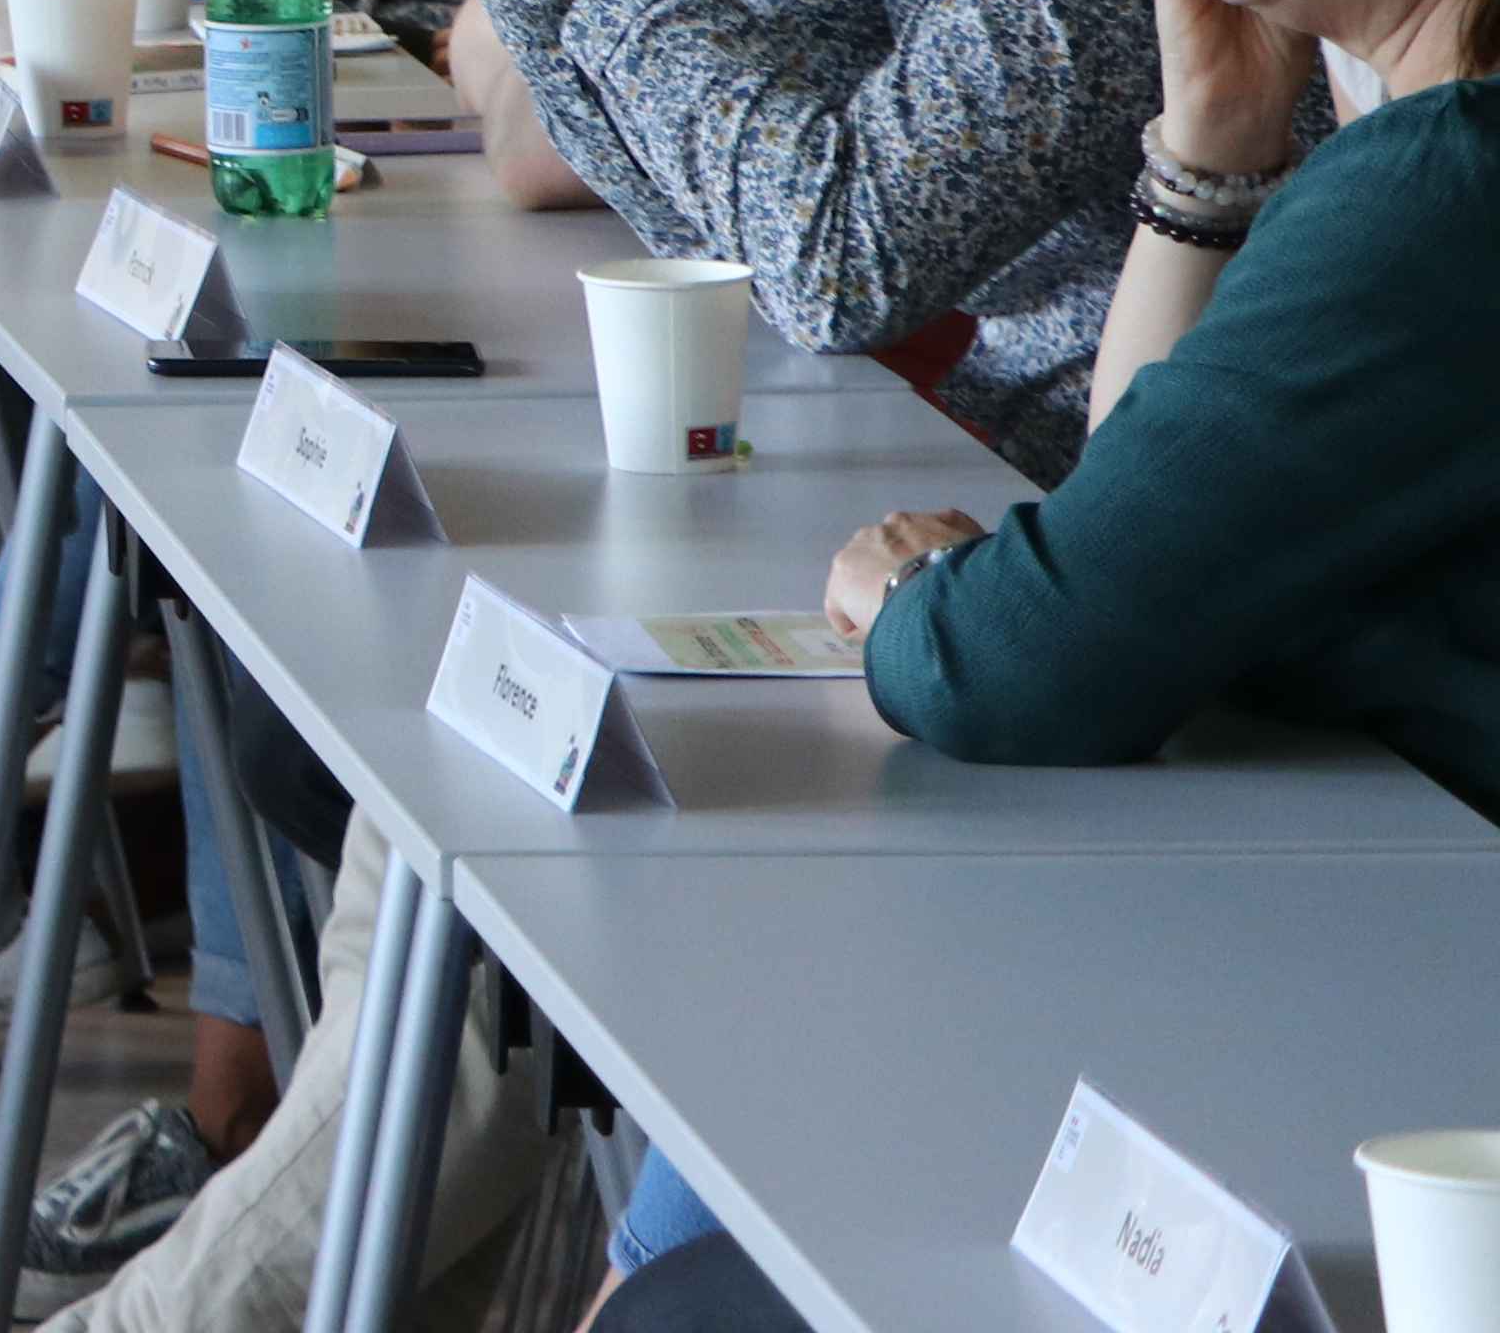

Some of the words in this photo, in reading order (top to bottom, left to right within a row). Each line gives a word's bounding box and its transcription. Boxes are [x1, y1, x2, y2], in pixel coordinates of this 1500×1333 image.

[296, 425, 328, 470] Sophie
[493, 662, 538, 721] Florence
[1115, 1207, 1166, 1277] Nadia
